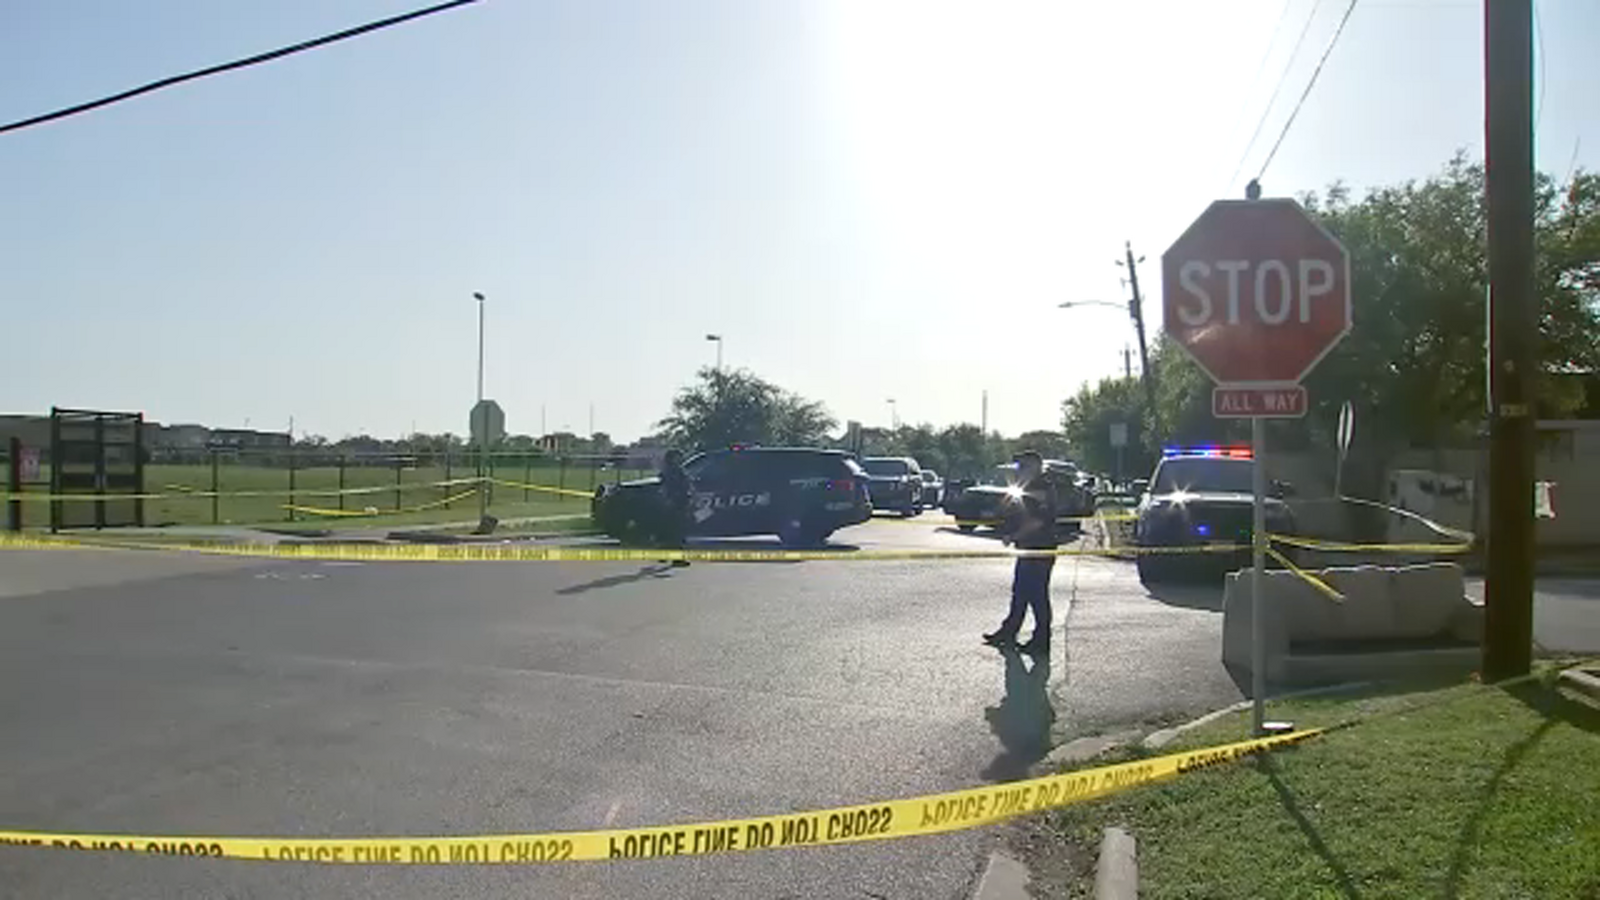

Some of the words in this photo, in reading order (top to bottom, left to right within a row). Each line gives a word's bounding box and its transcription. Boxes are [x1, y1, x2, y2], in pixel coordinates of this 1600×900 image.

[1177, 258, 1336, 326] STOP
[1221, 394, 1252, 411] ALL
[1263, 393, 1299, 410] WAY
[694, 492, 770, 508] OLICE
